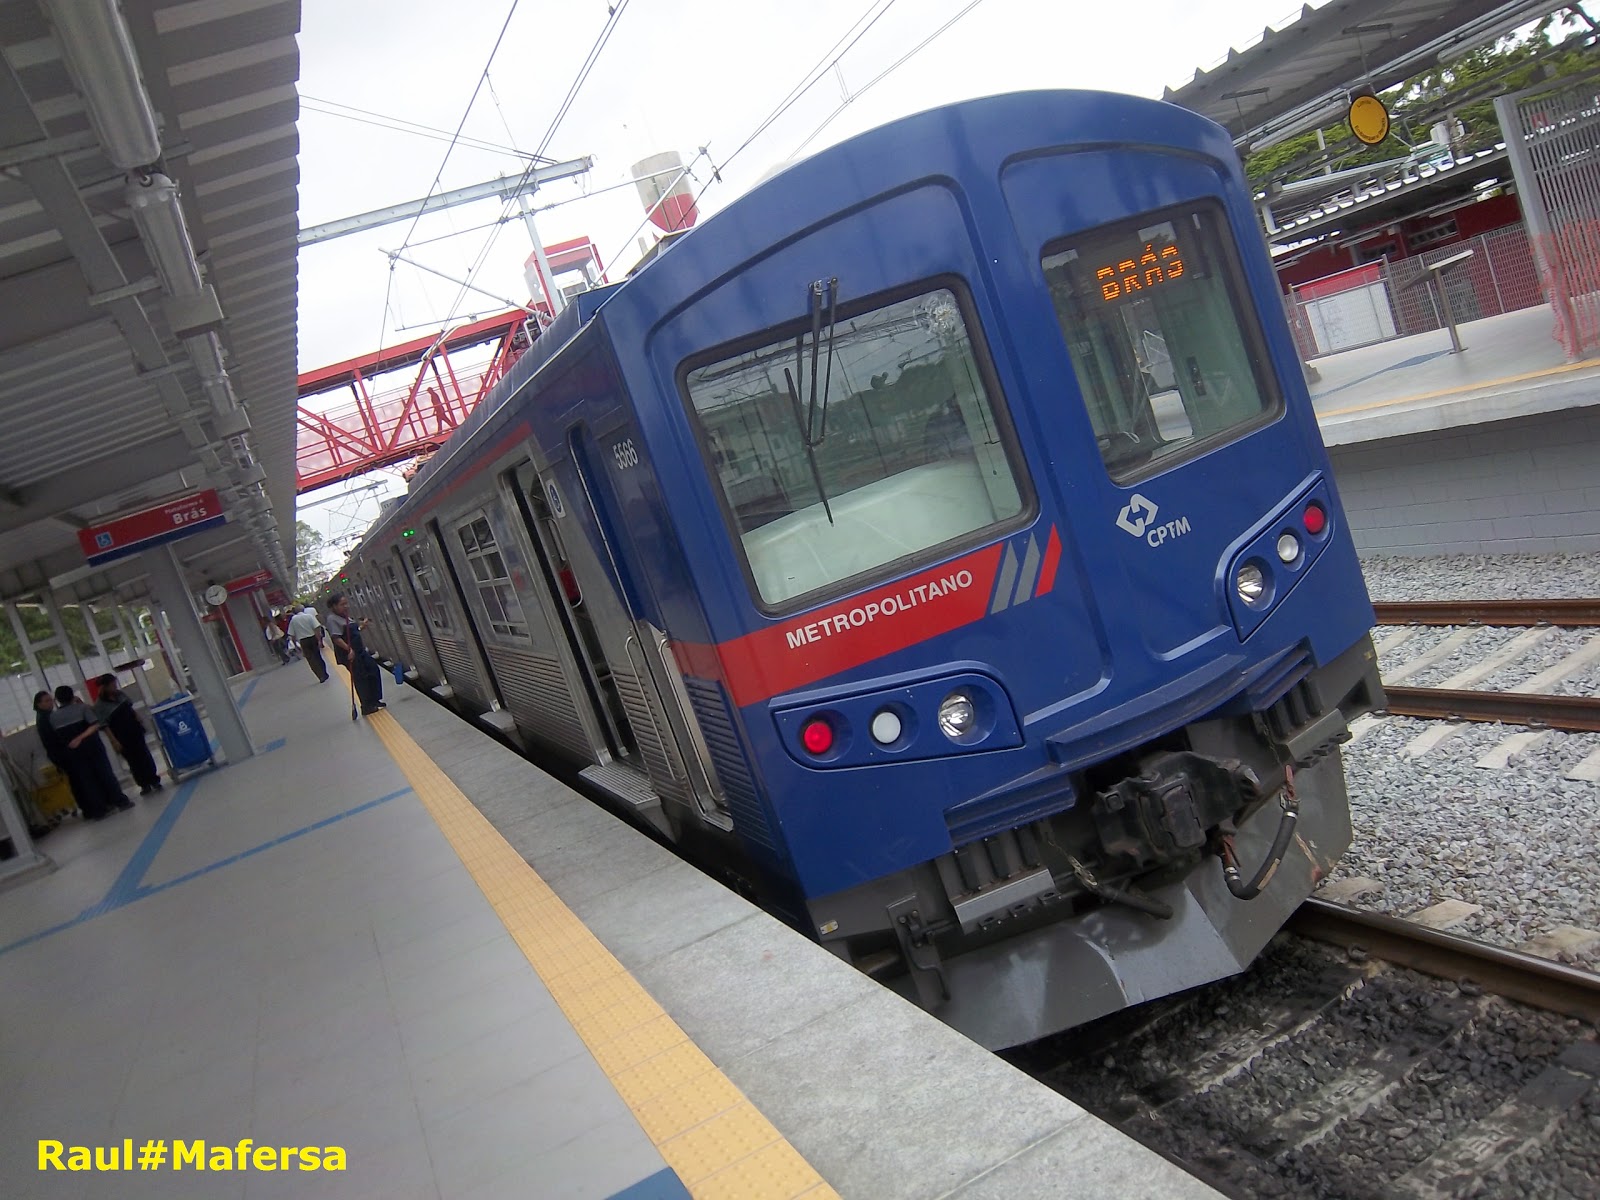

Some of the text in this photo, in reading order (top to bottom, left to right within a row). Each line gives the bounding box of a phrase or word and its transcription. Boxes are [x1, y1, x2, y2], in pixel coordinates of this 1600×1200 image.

[1096, 243, 1185, 301] BRÁS
[612, 438, 639, 470] 5566
[172, 507, 208, 525] Brás
[1147, 516, 1192, 548] CPTM
[785, 569, 973, 650] METROPOLITANO
